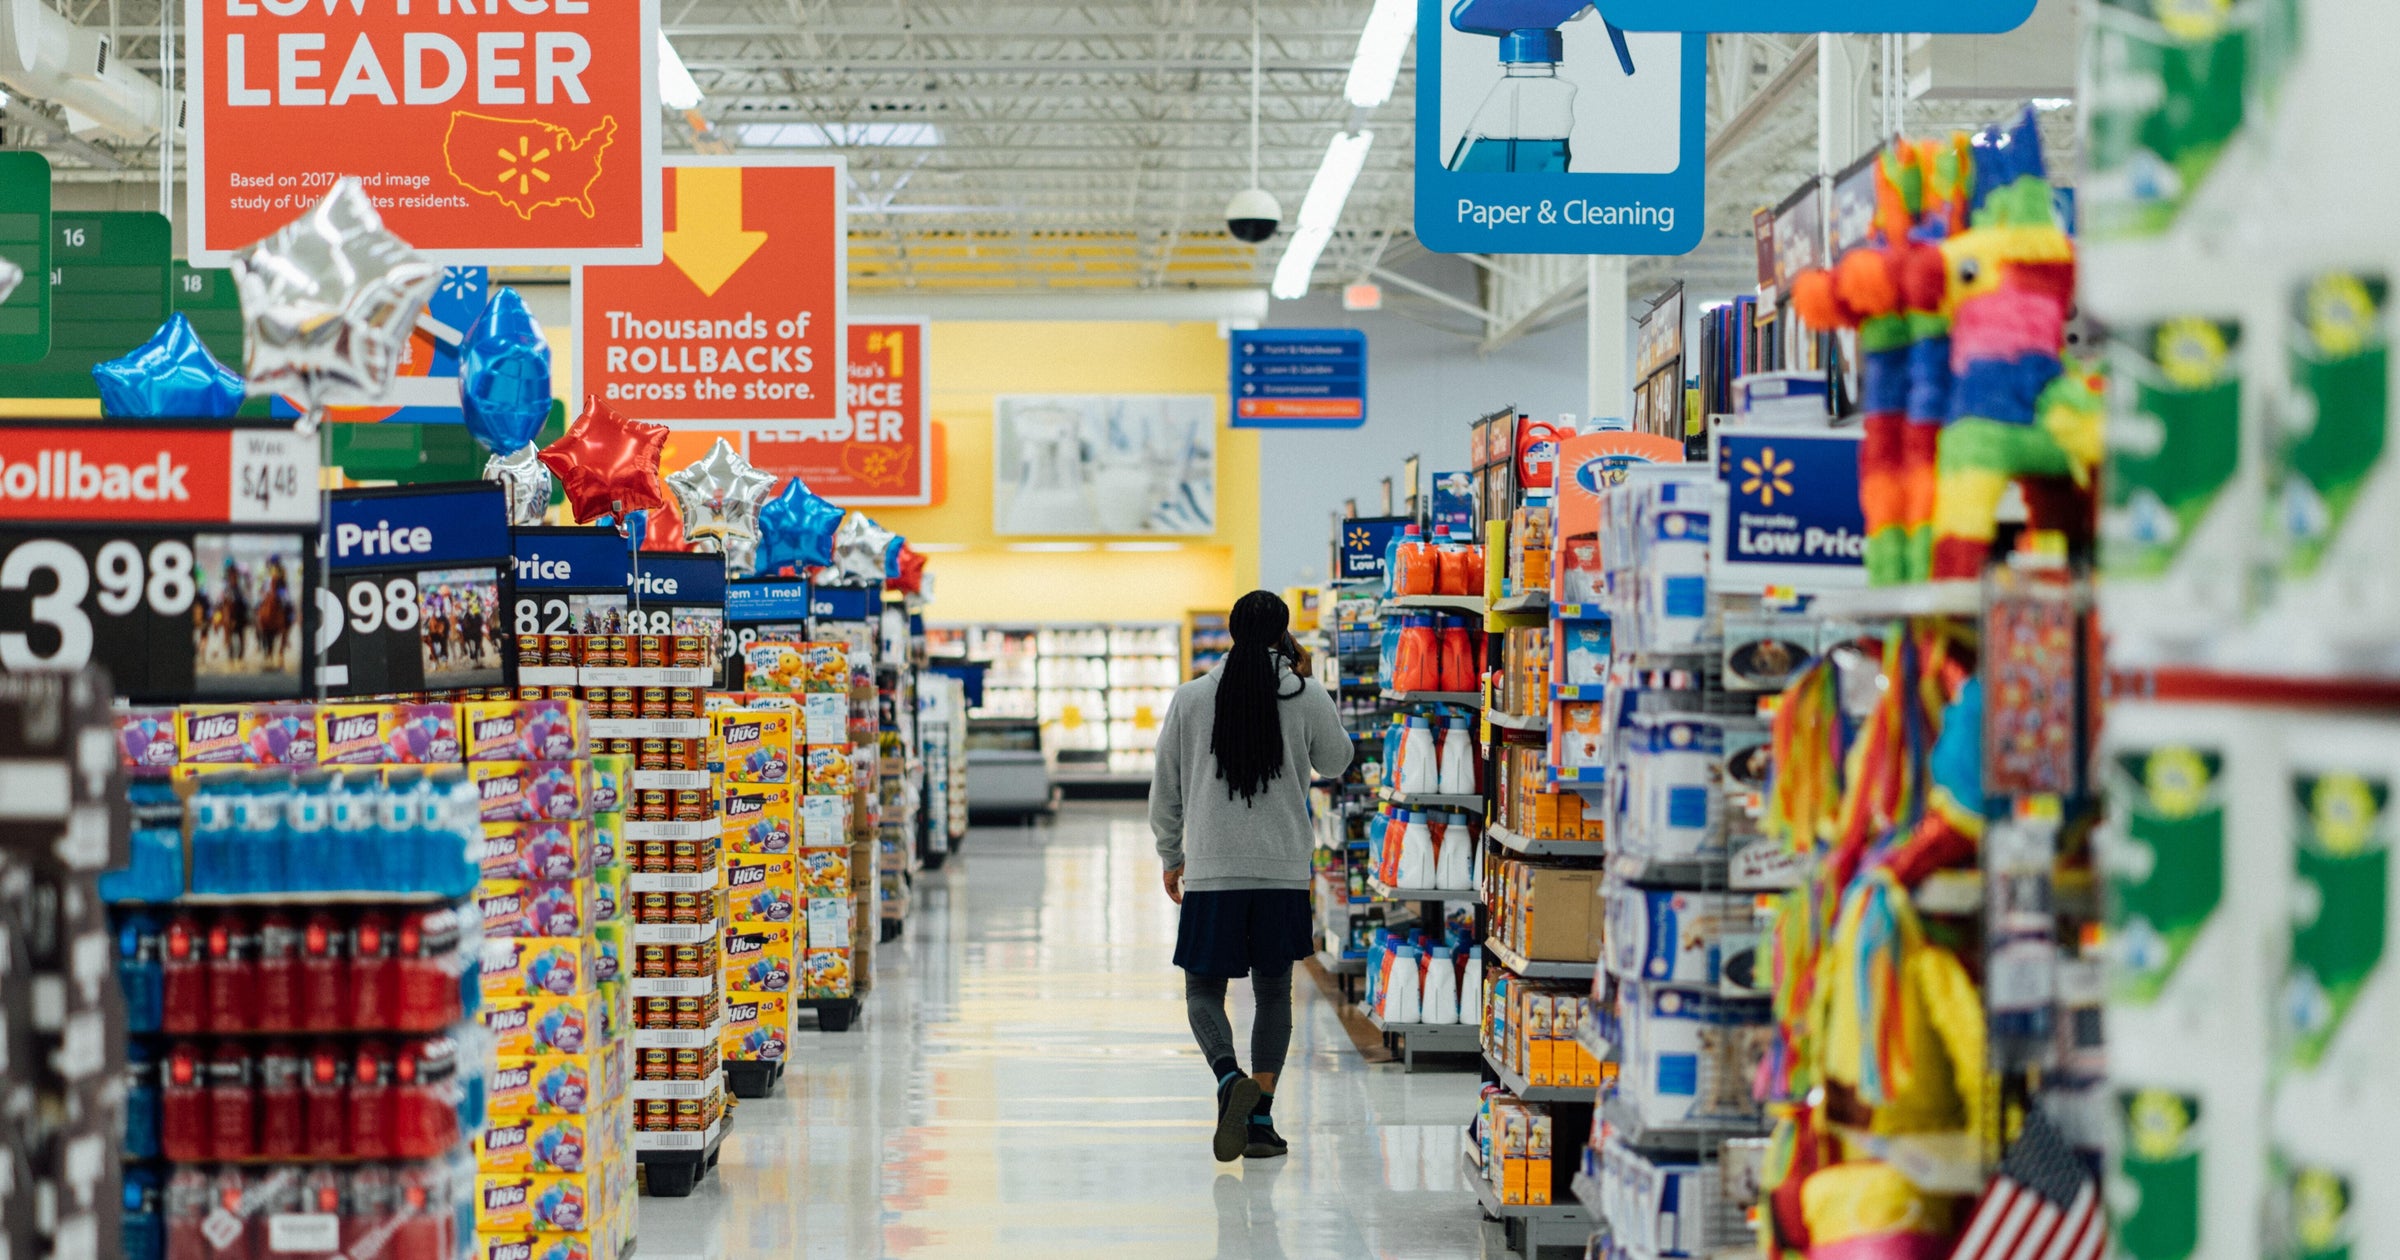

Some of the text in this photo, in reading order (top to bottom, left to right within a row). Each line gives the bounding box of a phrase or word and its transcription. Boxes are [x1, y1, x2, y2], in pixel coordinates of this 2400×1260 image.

[227, 32, 592, 106] LEADER
[230, 172, 430, 189] Based on 2017 and image
[230, 195, 270, 212] study
[275, 195, 291, 209] of
[398, 194, 470, 209] residents.
[1457, 198, 1675, 232] Paper & Cleaning
[63, 228, 85, 247] 16
[181, 275, 202, 292] 18
[605, 311, 811, 340] Thousands of
[606, 346, 813, 374] ROLLBACKS
[866, 330, 904, 378] #1
[605, 377, 815, 401] across the store.
[847, 383, 903, 407] RICE
[0, 450, 190, 501] ollback
[336, 520, 433, 558] Price
[1738, 526, 1869, 557] Low Pric
[1349, 560, 1376, 571] Low
[725, 589, 751, 599] tem
[771, 585, 801, 598] meal
[809, 597, 835, 616] ice
[514, 598, 570, 635] 82
[195, 717, 236, 742] HUG
[334, 720, 376, 743] HUG
[479, 720, 514, 741] HUG
[728, 729, 758, 743] HUG
[763, 722, 776, 731] 40
[764, 760, 784, 770] 75%
[484, 780, 519, 800] HUG
[766, 794, 778, 802] 40
[767, 832, 786, 841] 75%
[733, 870, 764, 886] HUG
[768, 864, 781, 873] 40
[485, 899, 520, 918] HUG
[770, 902, 788, 912] 75%
[766, 933, 778, 942] 40
[766, 971, 786, 980] 75%
[728, 1006, 757, 1023] HUG
[761, 1002, 774, 1010] 40
[492, 1011, 526, 1032] HUG
[763, 1040, 782, 1050] 75%
[493, 1071, 528, 1090] HUG
[489, 1129, 524, 1150] HUG
[489, 1188, 524, 1208] HUG
